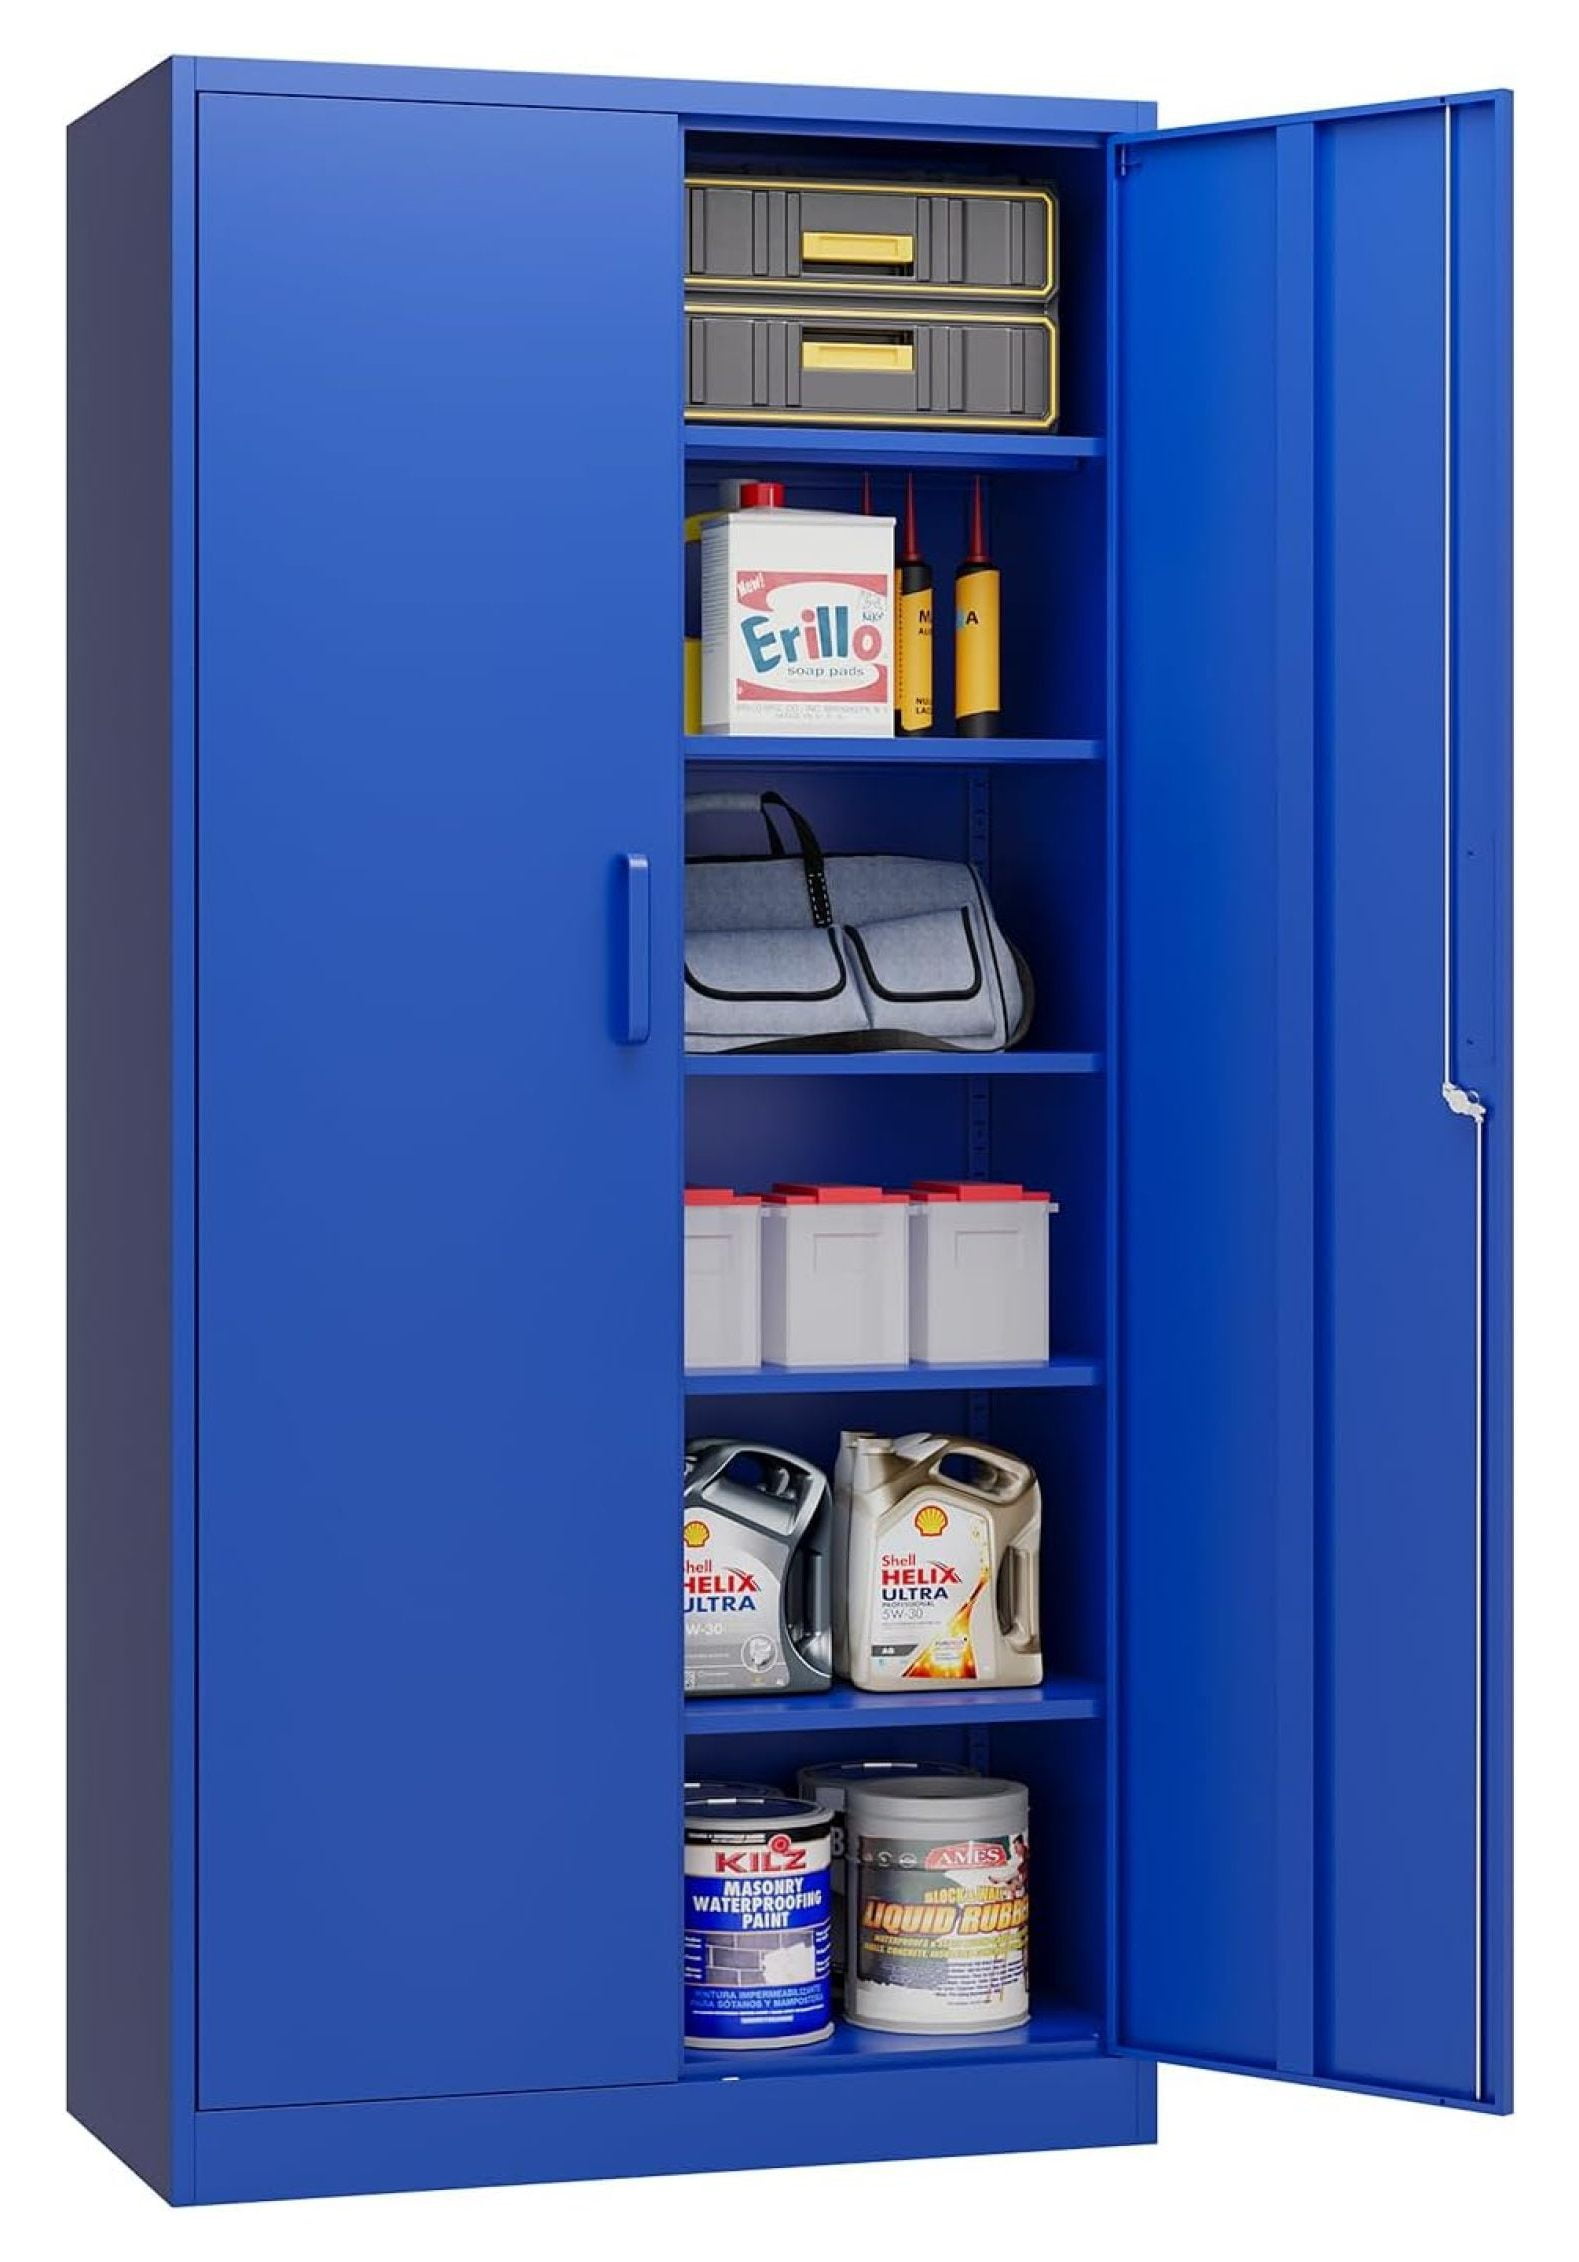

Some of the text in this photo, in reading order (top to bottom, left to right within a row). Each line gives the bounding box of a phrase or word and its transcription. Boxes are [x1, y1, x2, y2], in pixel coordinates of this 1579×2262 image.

[787, 665, 865, 677] soap pads
[684, 1559, 712, 1573] hell
[881, 1552, 916, 1566] Shell
[881, 1567, 959, 1586] HELIX
[881, 1587, 949, 1600] ULTRA
[881, 1600, 935, 1608] PROFESSIONAL
[881, 1608, 924, 1620] 5W-30
[715, 1849, 806, 1873] KILZ
[939, 1849, 1000, 1865] AMES
[723, 1877, 804, 1896] MASONRY
[693, 1890, 822, 1913] WATERPROOFING
[742, 1911, 790, 1929] PAINT
[862, 1899, 957, 1935] LIQUID
